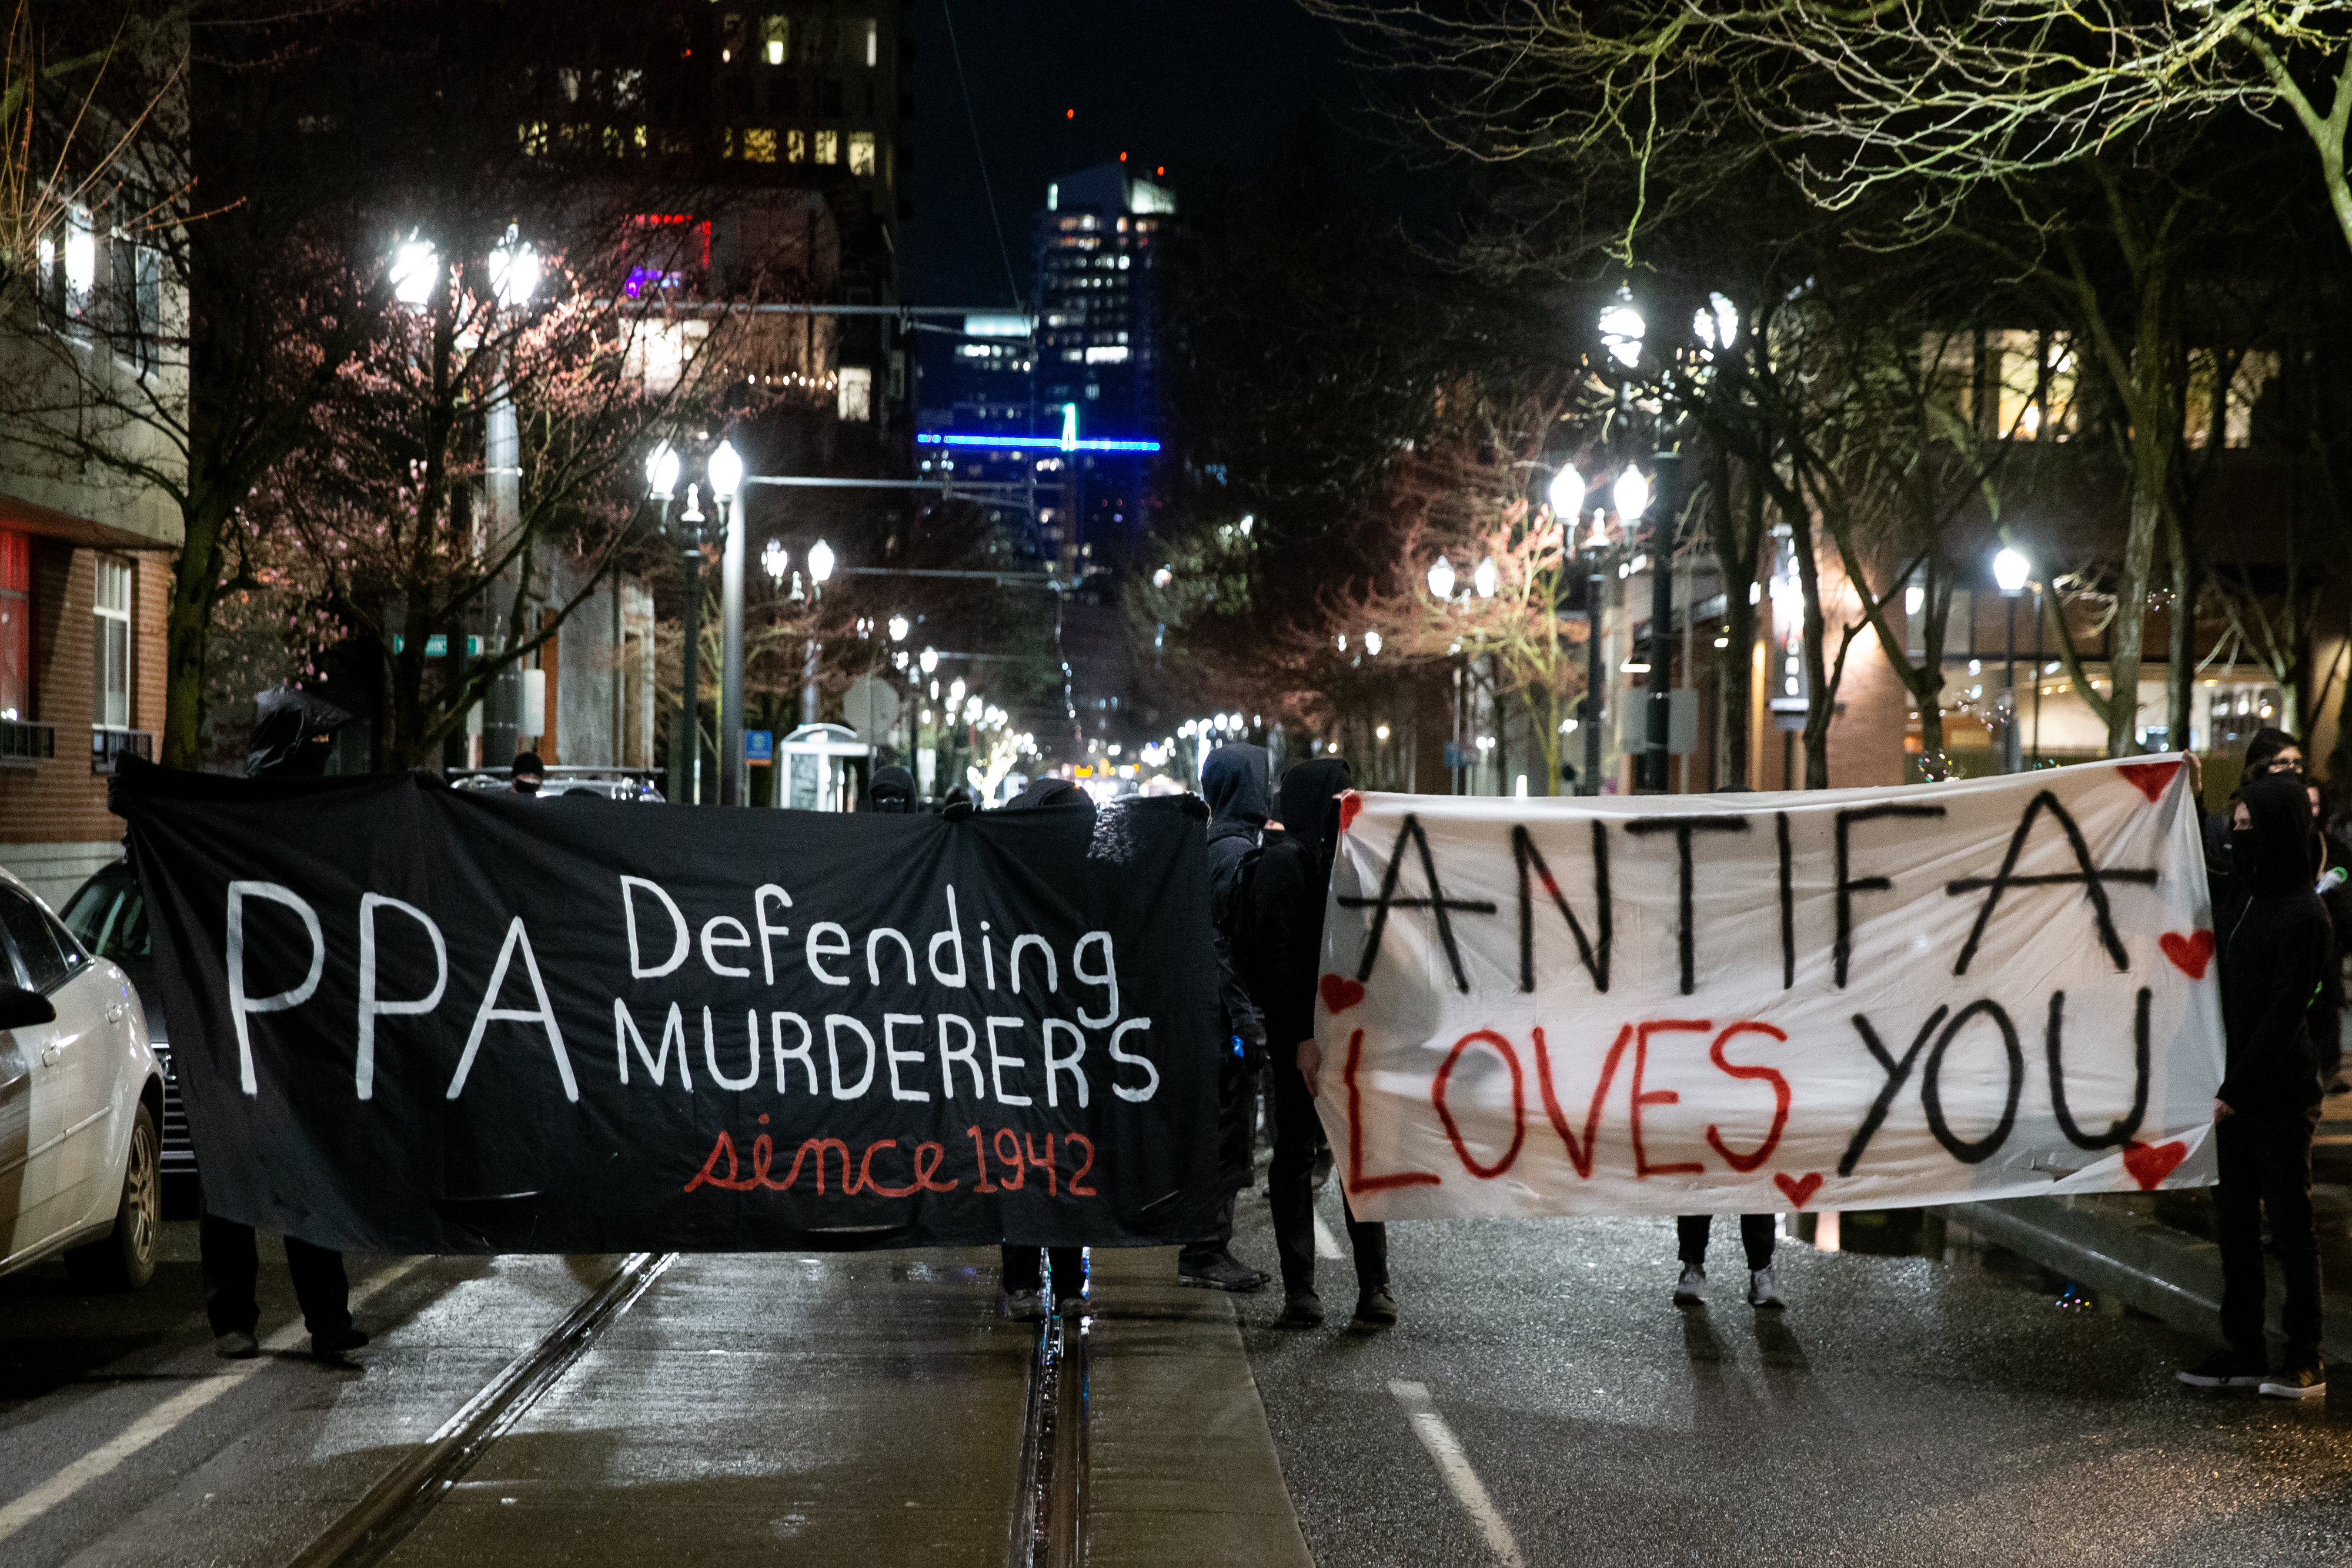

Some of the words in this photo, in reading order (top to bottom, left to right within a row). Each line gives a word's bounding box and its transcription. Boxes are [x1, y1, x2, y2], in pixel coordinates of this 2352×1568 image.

[619, 874, 1120, 1030] Defending
[1337, 790, 2159, 995] ANTIFA
[226, 880, 580, 1103] PPA
[613, 997, 1160, 1108] MURDERERS
[684, 1112, 959, 1197] since
[966, 1124, 1098, 1197] 1942
[1344, 1018, 1792, 1195] LOVES
[1838, 987, 2153, 1177] YOU
